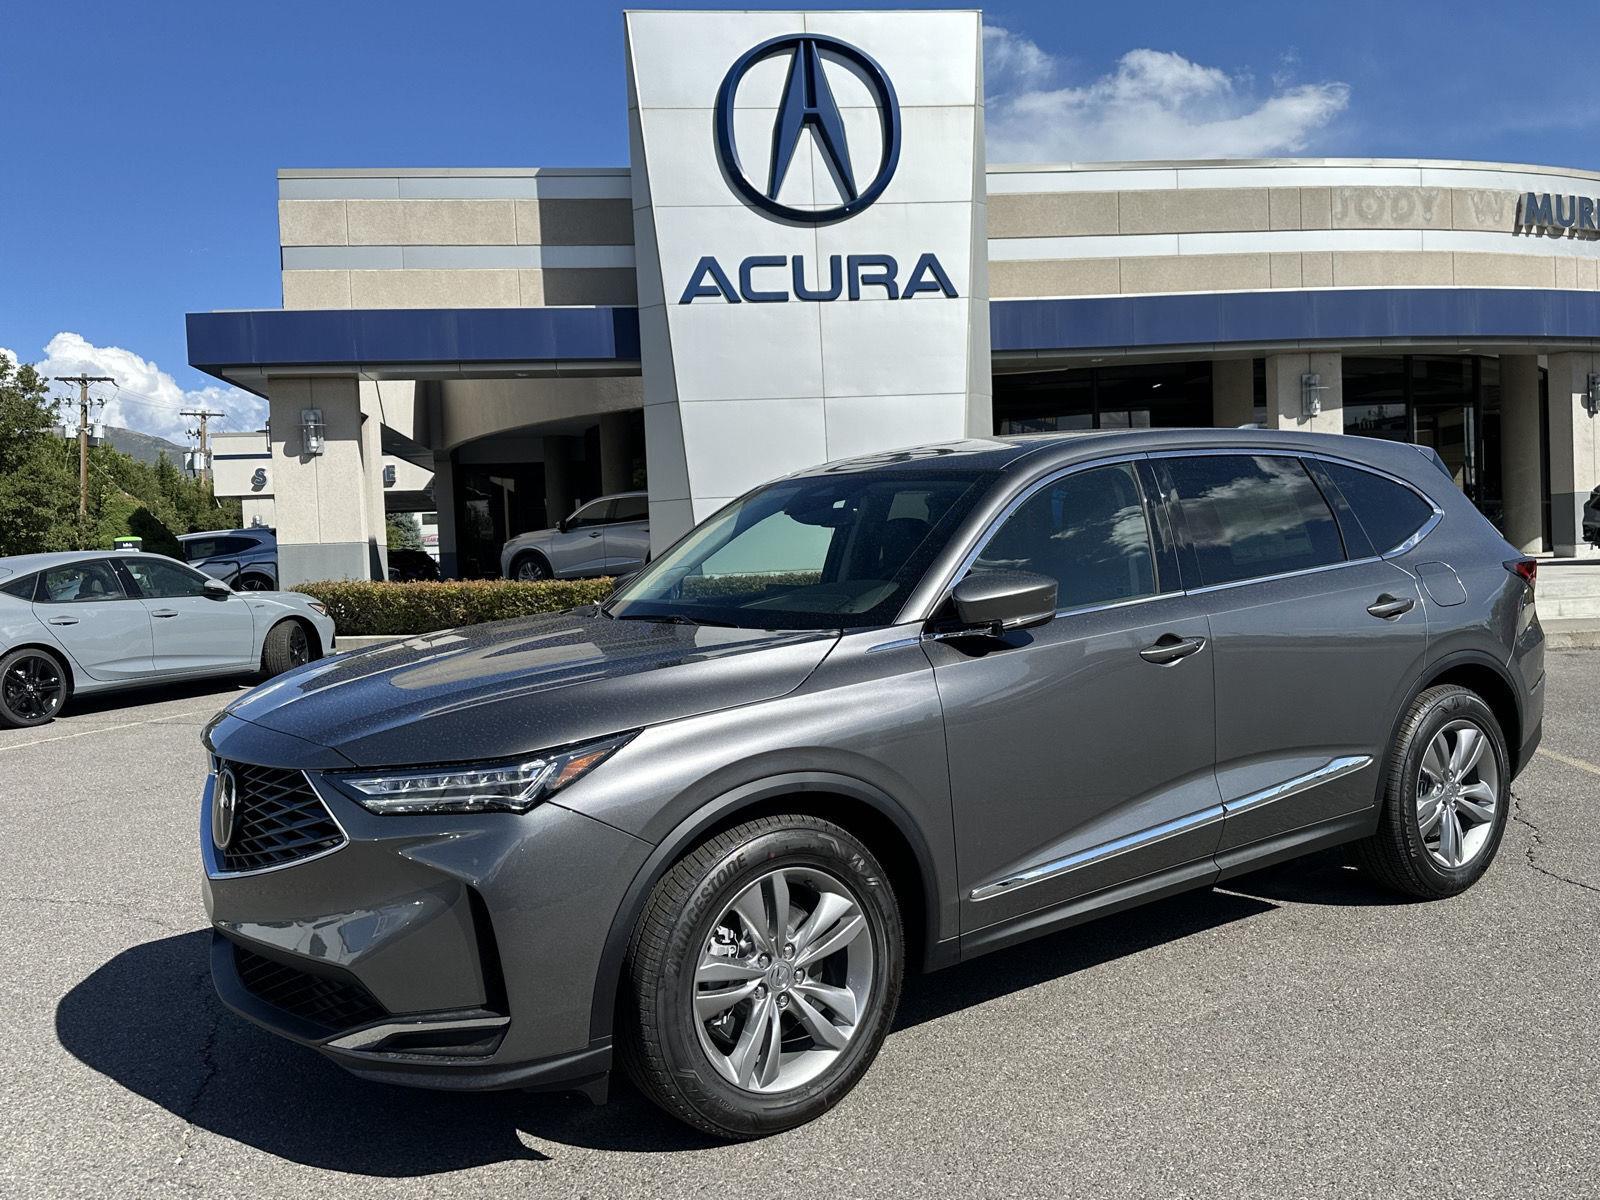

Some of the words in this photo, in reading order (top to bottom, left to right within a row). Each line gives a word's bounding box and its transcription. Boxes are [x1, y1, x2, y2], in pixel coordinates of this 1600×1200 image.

[1333, 187, 1440, 224] JODY
[1524, 192, 1600, 230] MUR
[678, 253, 959, 305] ACURA
[1403, 763, 1418, 858] BRIDGESTO
[663, 852, 747, 976] BRIDGESTONE
